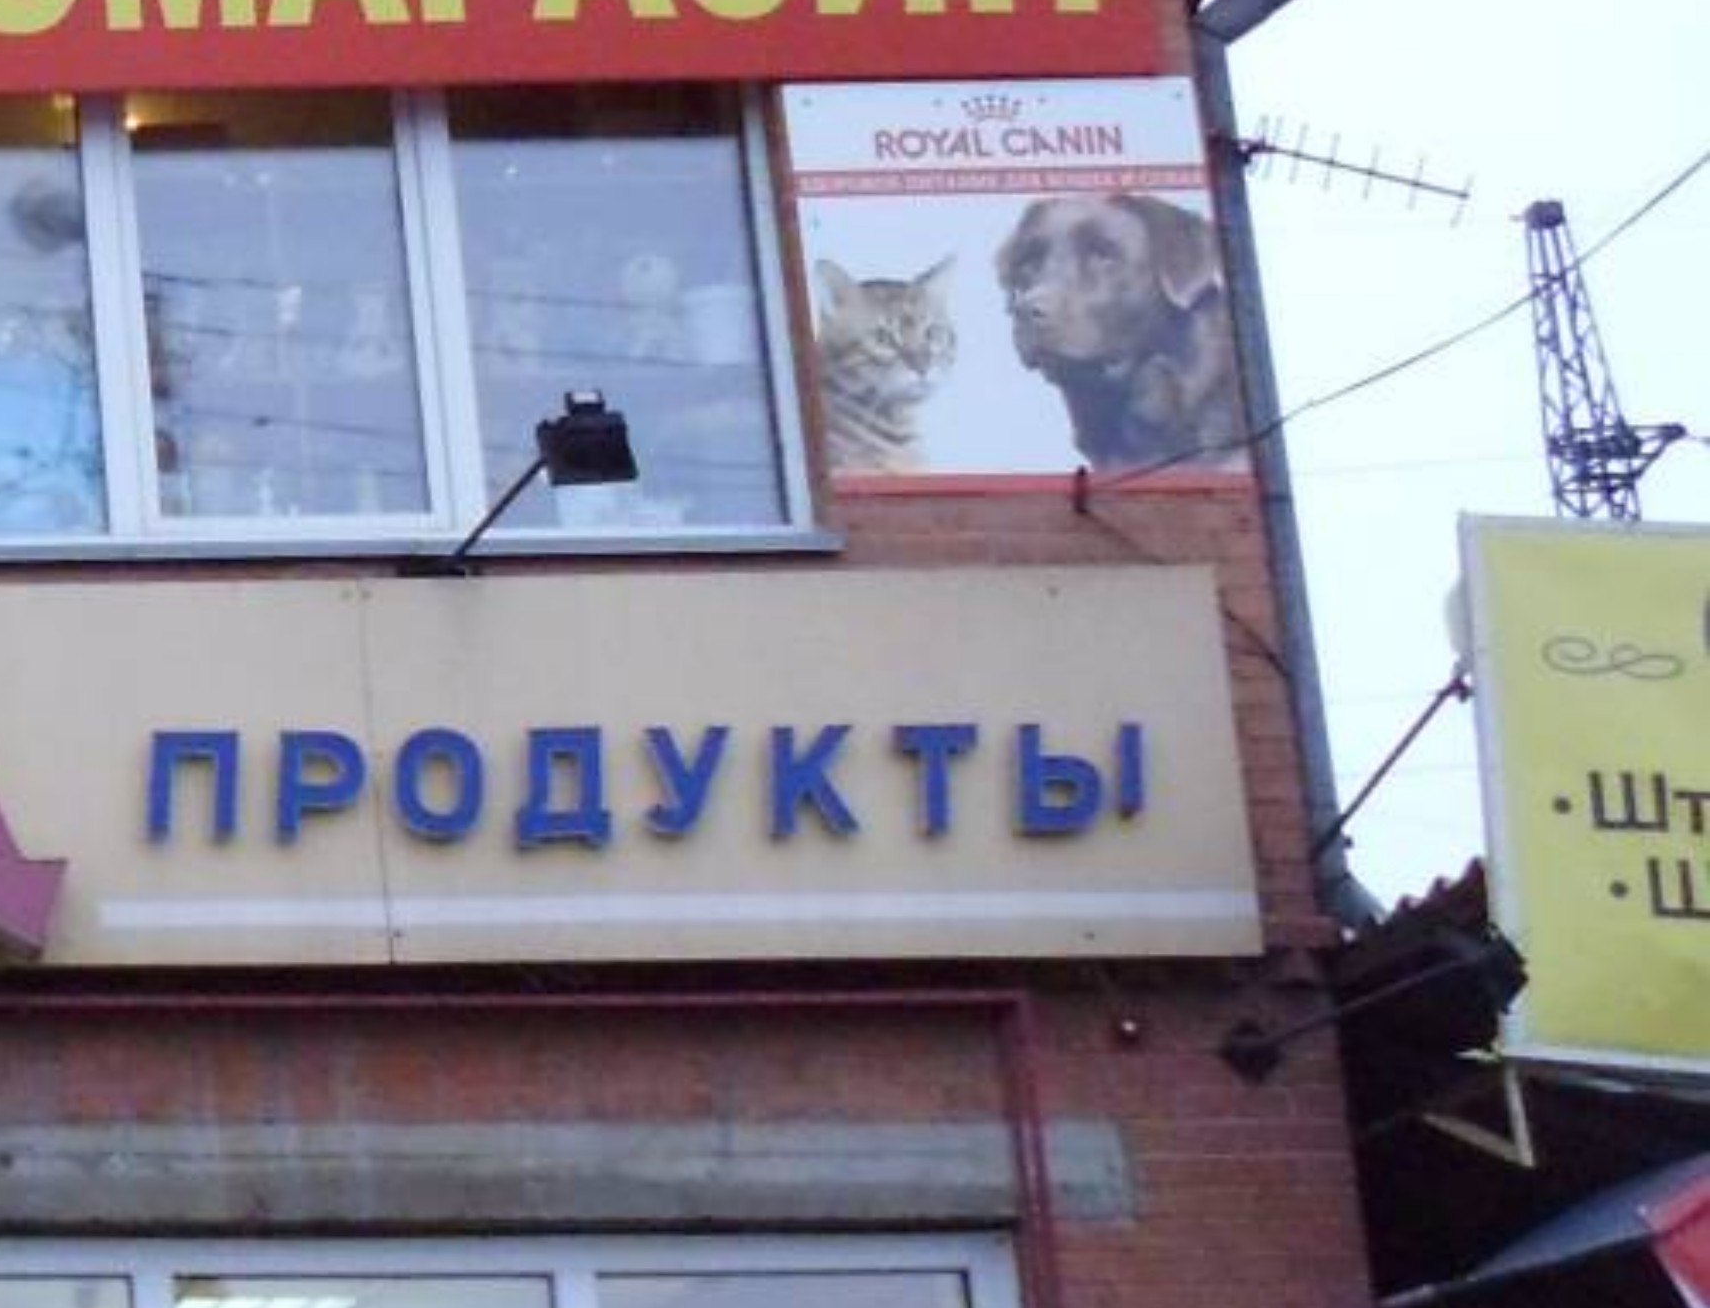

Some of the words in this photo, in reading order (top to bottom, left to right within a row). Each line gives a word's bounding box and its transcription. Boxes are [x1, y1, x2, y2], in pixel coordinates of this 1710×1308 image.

[873, 127, 995, 159] ROYAL
[1001, 125, 1123, 156] CANIN
[147, 722, 1147, 854] ПРОДУКТЫ
